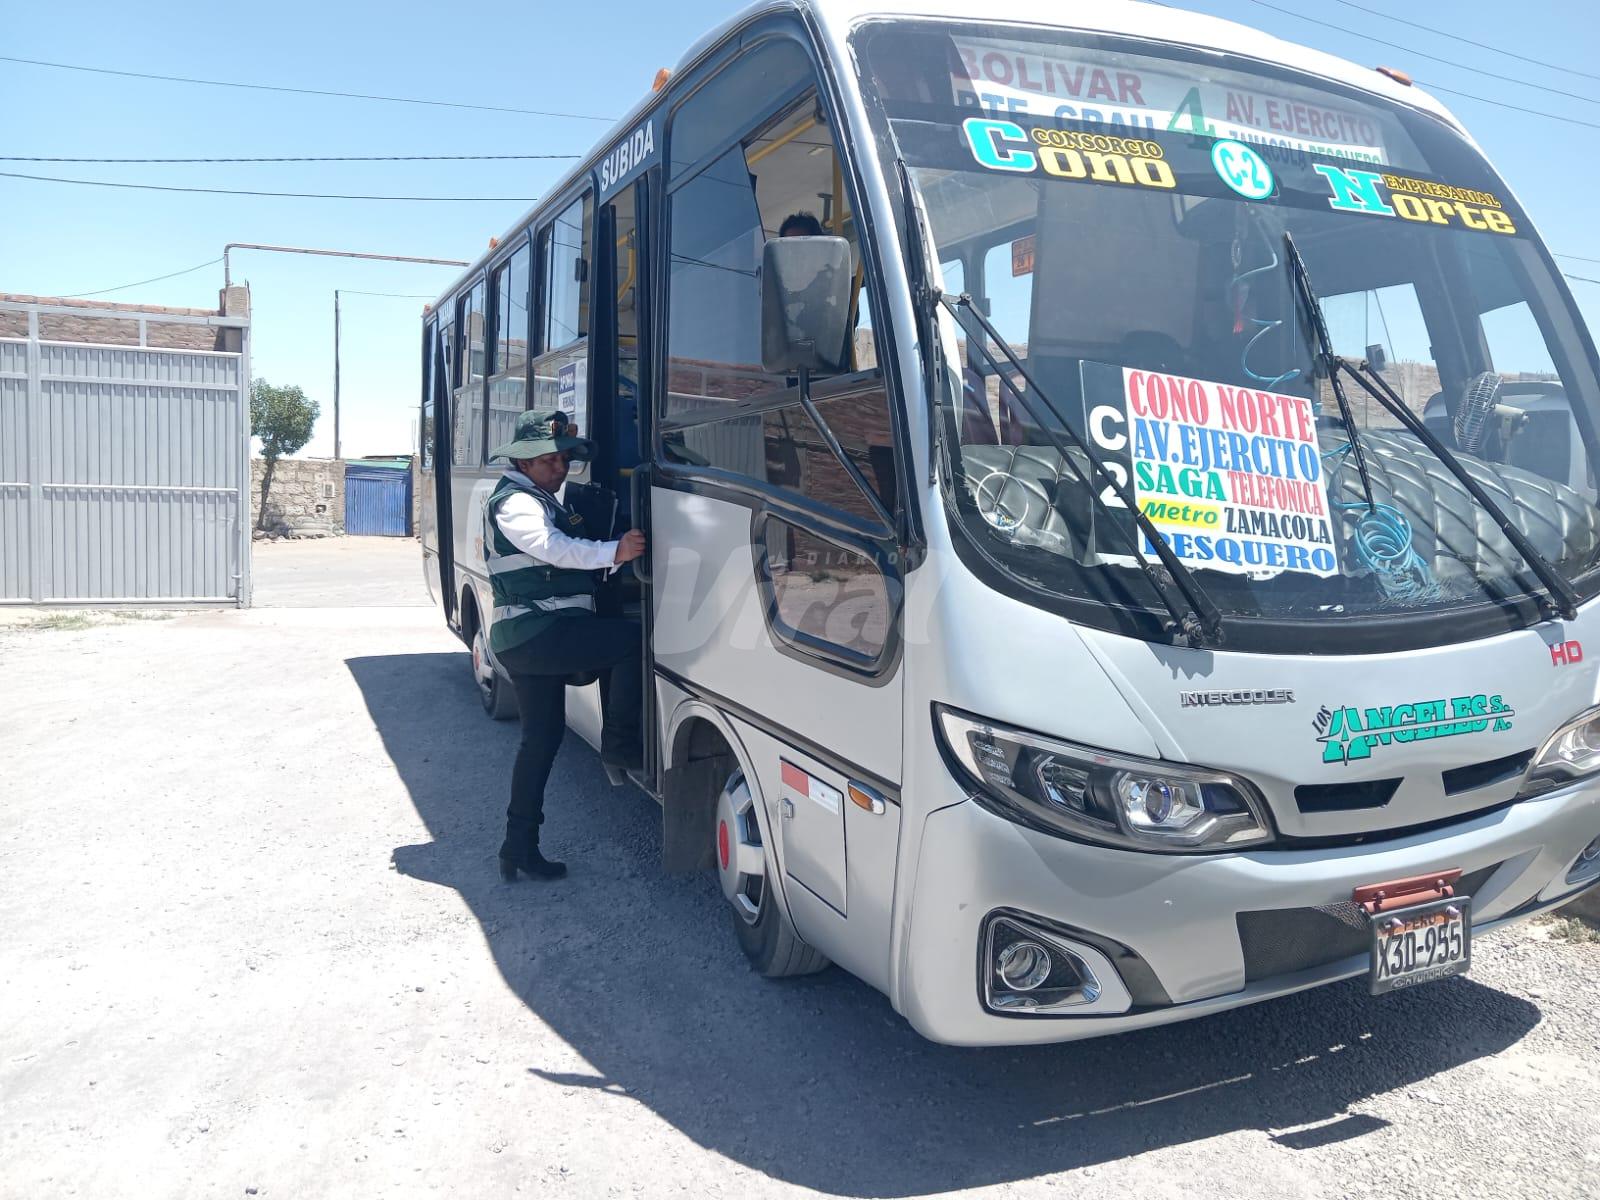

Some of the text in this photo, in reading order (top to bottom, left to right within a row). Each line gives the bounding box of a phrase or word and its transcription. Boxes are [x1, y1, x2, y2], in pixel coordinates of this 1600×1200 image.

[954, 48, 1146, 105] BOLIVAR
[1054, 104, 1156, 140] GRAU
[1226, 92, 1377, 146] AV. EJERCITO
[601, 120, 655, 192] SUBIDA
[1031, 127, 1163, 159] CONSORCIO
[1382, 174, 1502, 209] EMPRESARIAL
[1089, 405, 1128, 450] C
[1128, 371, 1314, 443] CONO NORTE
[1096, 461, 1128, 508] 2
[1136, 461, 1325, 516] SAGA TELEFONICA
[1142, 501, 1333, 544] Metro ZAMACOLA
[1143, 532, 1336, 572] PESQUERO
[1549, 640, 1584, 666] HD
[1180, 688, 1297, 707] INTERCOOLER
[1311, 704, 1332, 736] LOS
[1322, 694, 1489, 765] ANGELES
[1377, 920, 1461, 979] X3D-955
